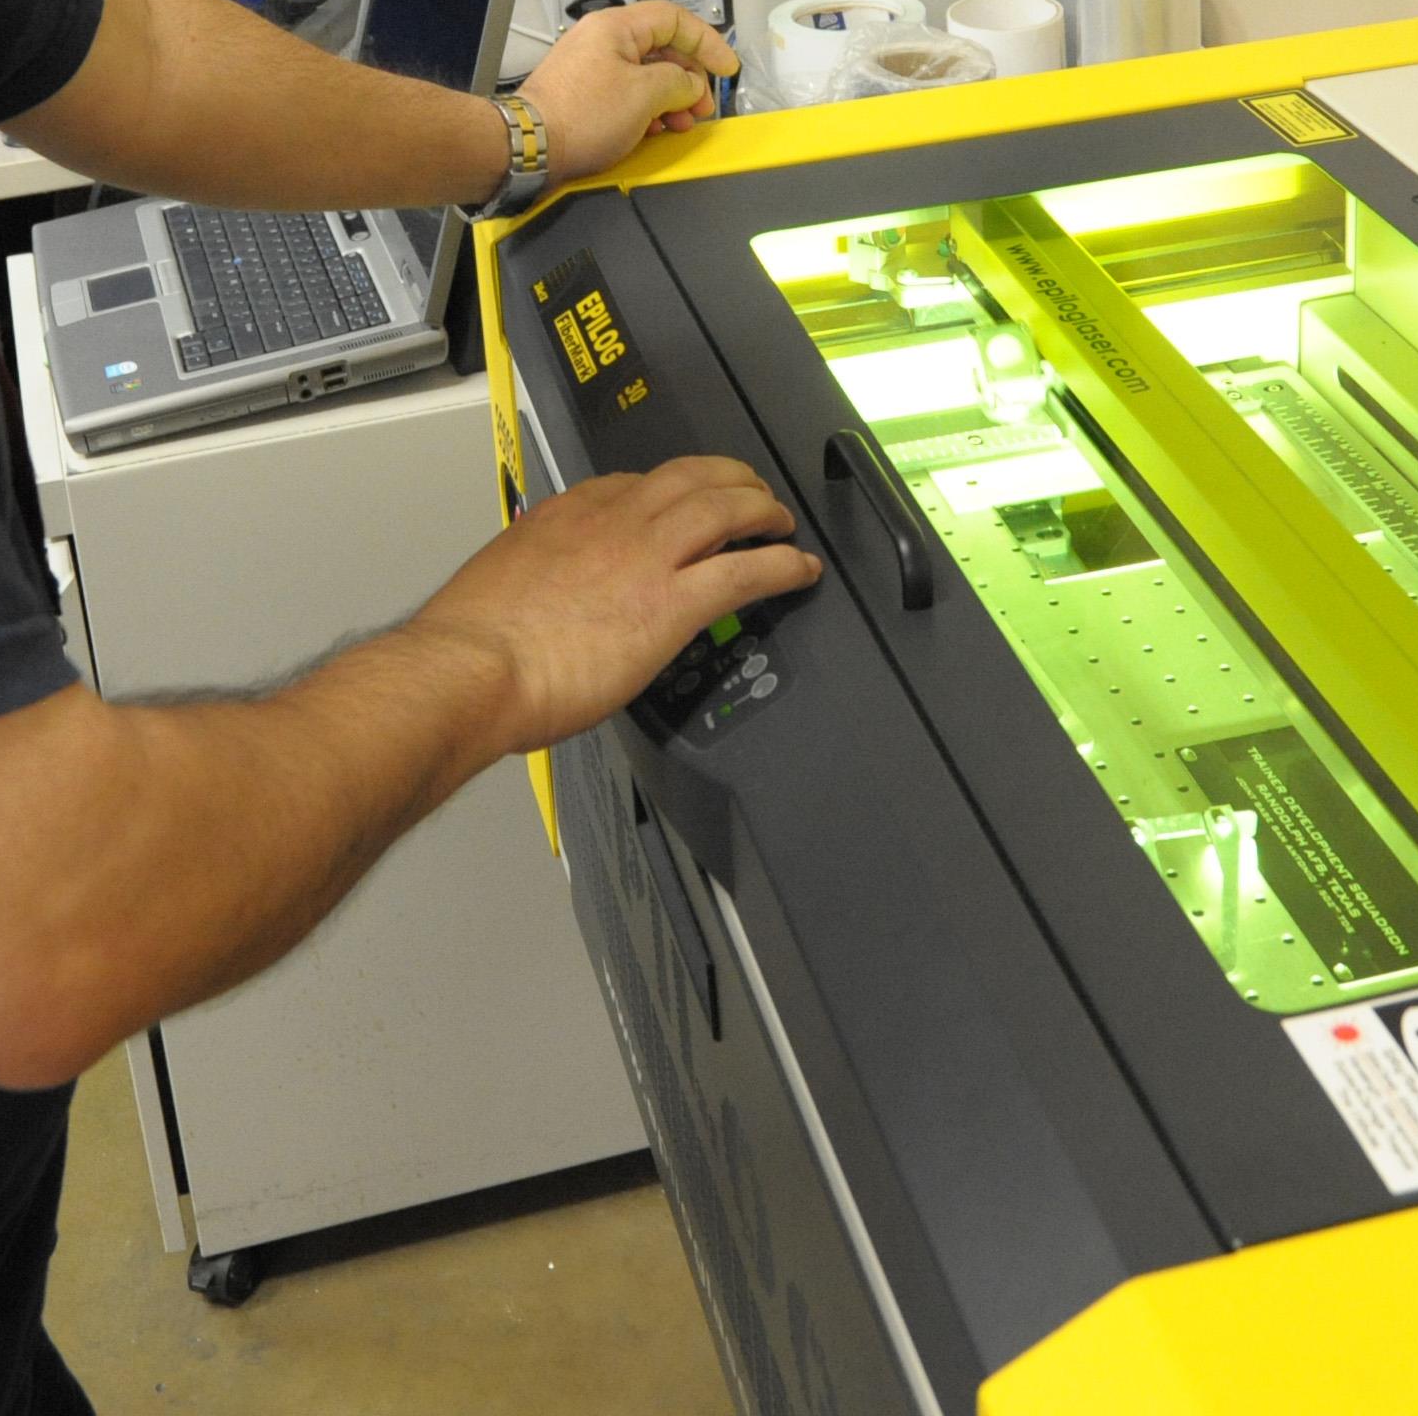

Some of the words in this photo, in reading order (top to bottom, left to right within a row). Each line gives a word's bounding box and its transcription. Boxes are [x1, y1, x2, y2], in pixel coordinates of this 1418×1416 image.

[556, 314, 594, 379] FiberMark
[575, 290, 626, 366] EPILOG
[1007, 243, 1151, 393] www.epiloglaser.com
[625, 378, 648, 404] 30
[1235, 776, 1257, 800] JOINT
[1254, 801, 1274, 824] BASE
[1271, 825, 1288, 843] SAN
[1286, 845, 1317, 883] ANTONIO
[1248, 746, 1287, 794] TRAINER
[1283, 796, 1354, 880] DEVELOPMENT
[1348, 882, 1410, 955] SQUADRON
[1255, 784, 1308, 846] RANDOLPH
[1304, 848, 1328, 877] AFB,
[1327, 878, 1362, 918] TEXAS
